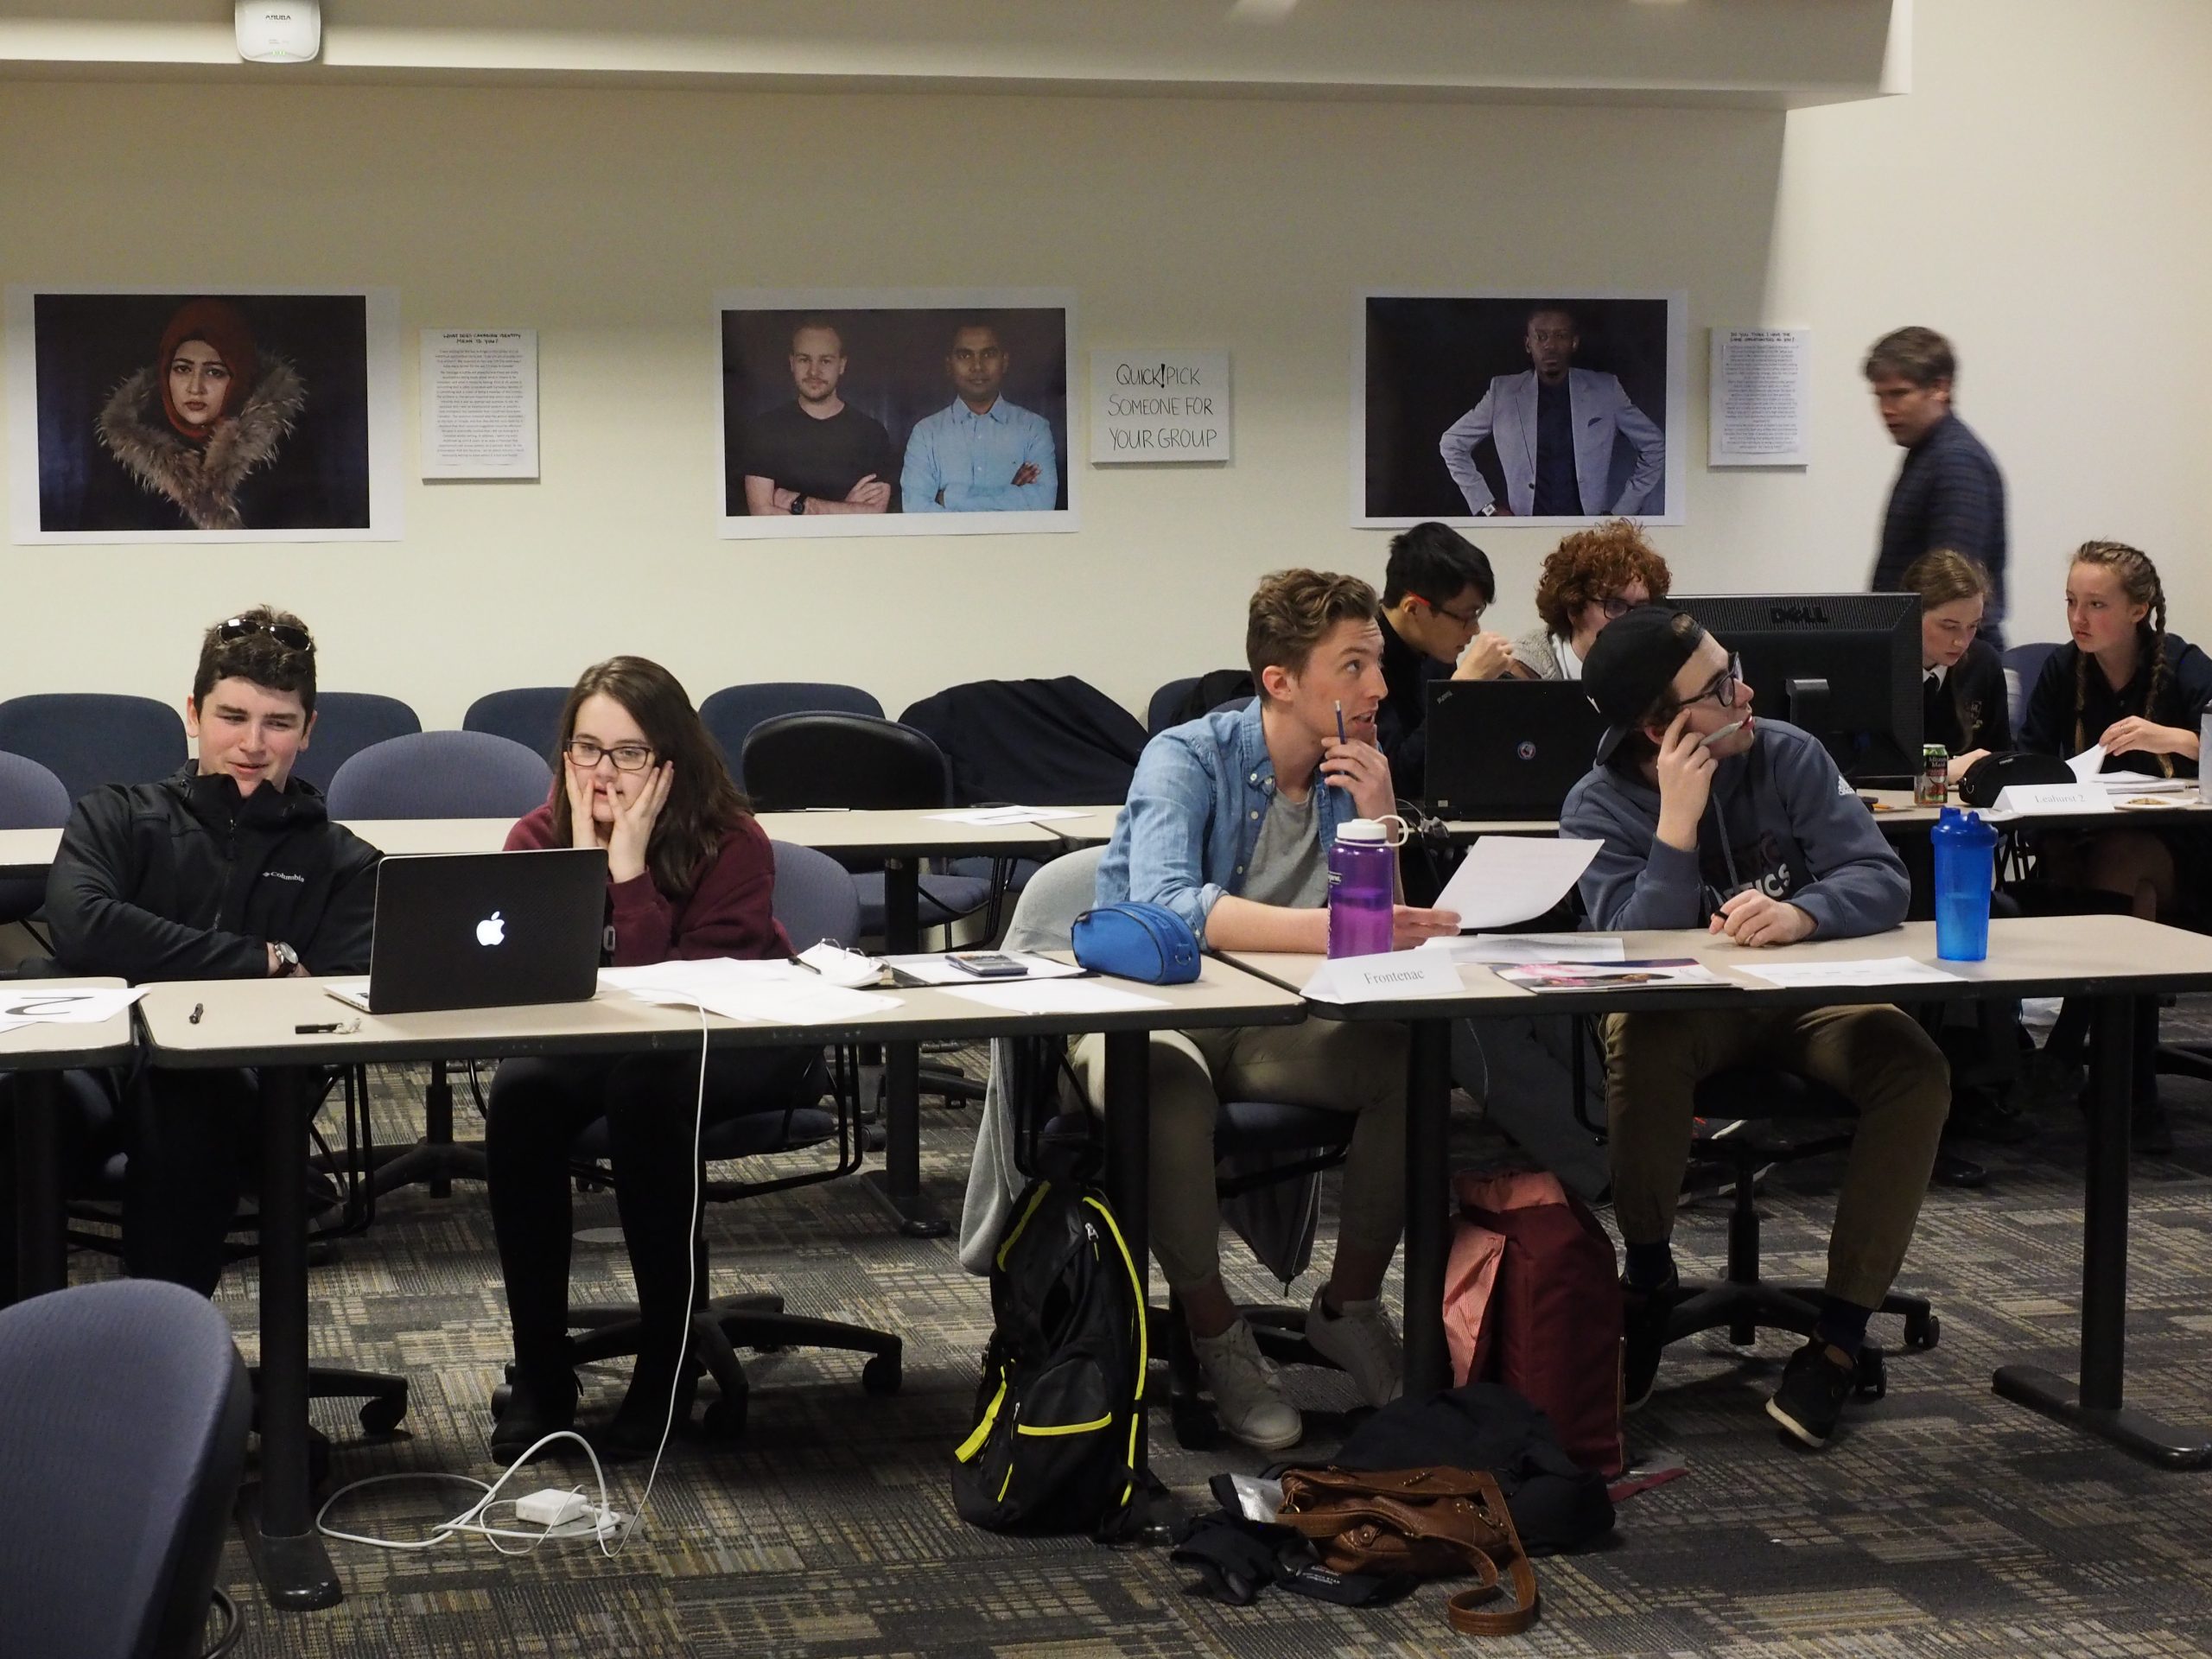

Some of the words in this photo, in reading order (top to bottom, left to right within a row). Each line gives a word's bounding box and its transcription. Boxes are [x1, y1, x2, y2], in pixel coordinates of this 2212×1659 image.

[1166, 366, 1201, 385] PICK
[1108, 393, 1181, 416] SOMEONE
[1185, 397, 1214, 416] FOR
[1109, 428, 1154, 451] YOUR
[1157, 428, 1217, 448] GROUP
[1769, 606, 1828, 623] DELL
[2034, 794, 2076, 804] Leahurst
[2078, 794, 2087, 803] 2
[270, 871, 305, 882] Columbia
[1363, 969, 1425, 985] Frontenac
